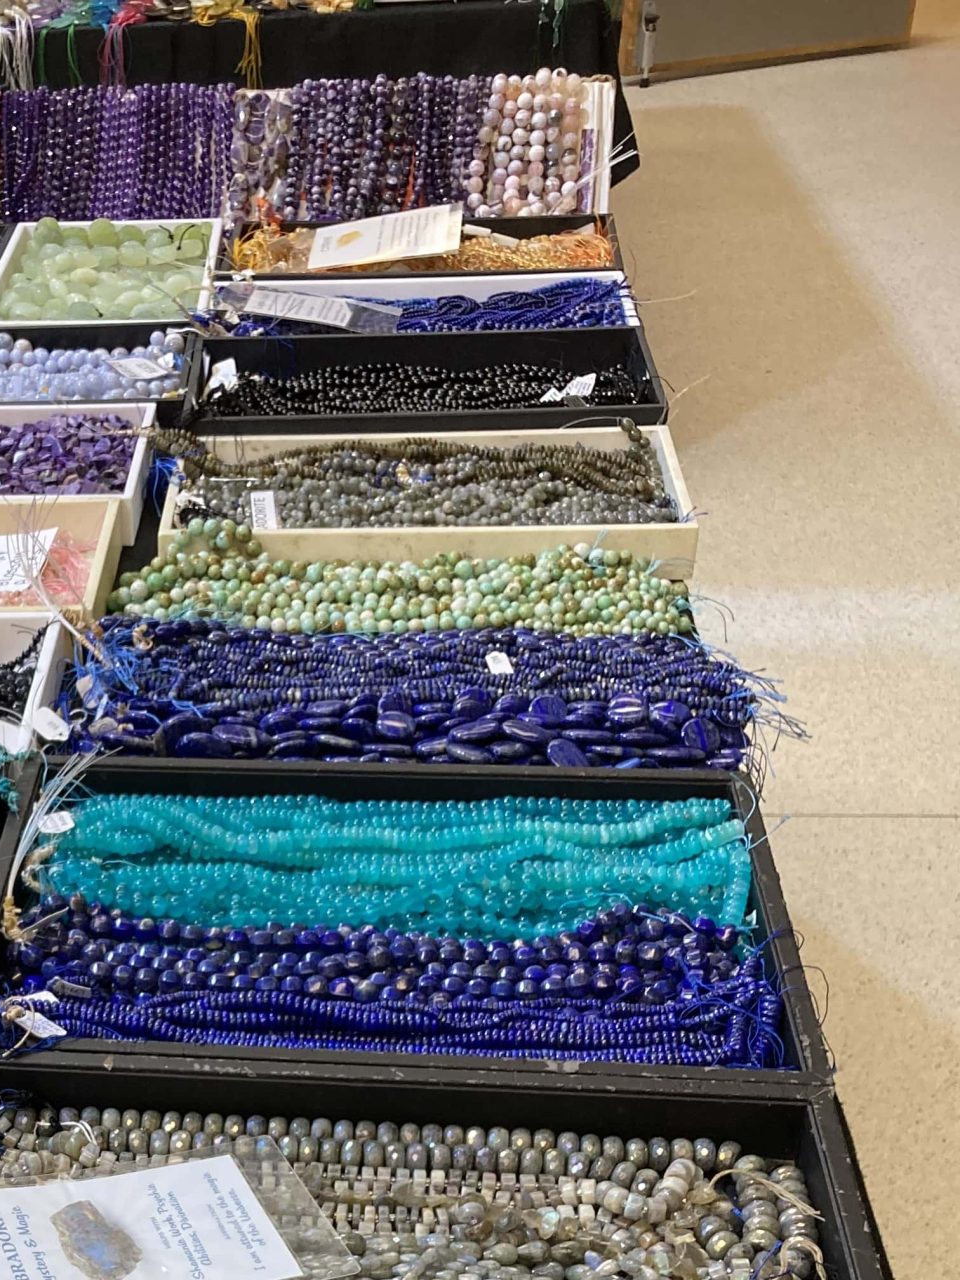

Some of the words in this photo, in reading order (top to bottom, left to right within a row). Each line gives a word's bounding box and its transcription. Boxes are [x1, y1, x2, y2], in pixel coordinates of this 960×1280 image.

[147, 1183, 168, 1214] Psychic
[216, 1195, 229, 1209] the
[11, 1204, 32, 1235] Magic
[24, 1238, 37, 1248] &
[178, 1238, 205, 1280] Shamanic
[249, 1251, 261, 1264] am
